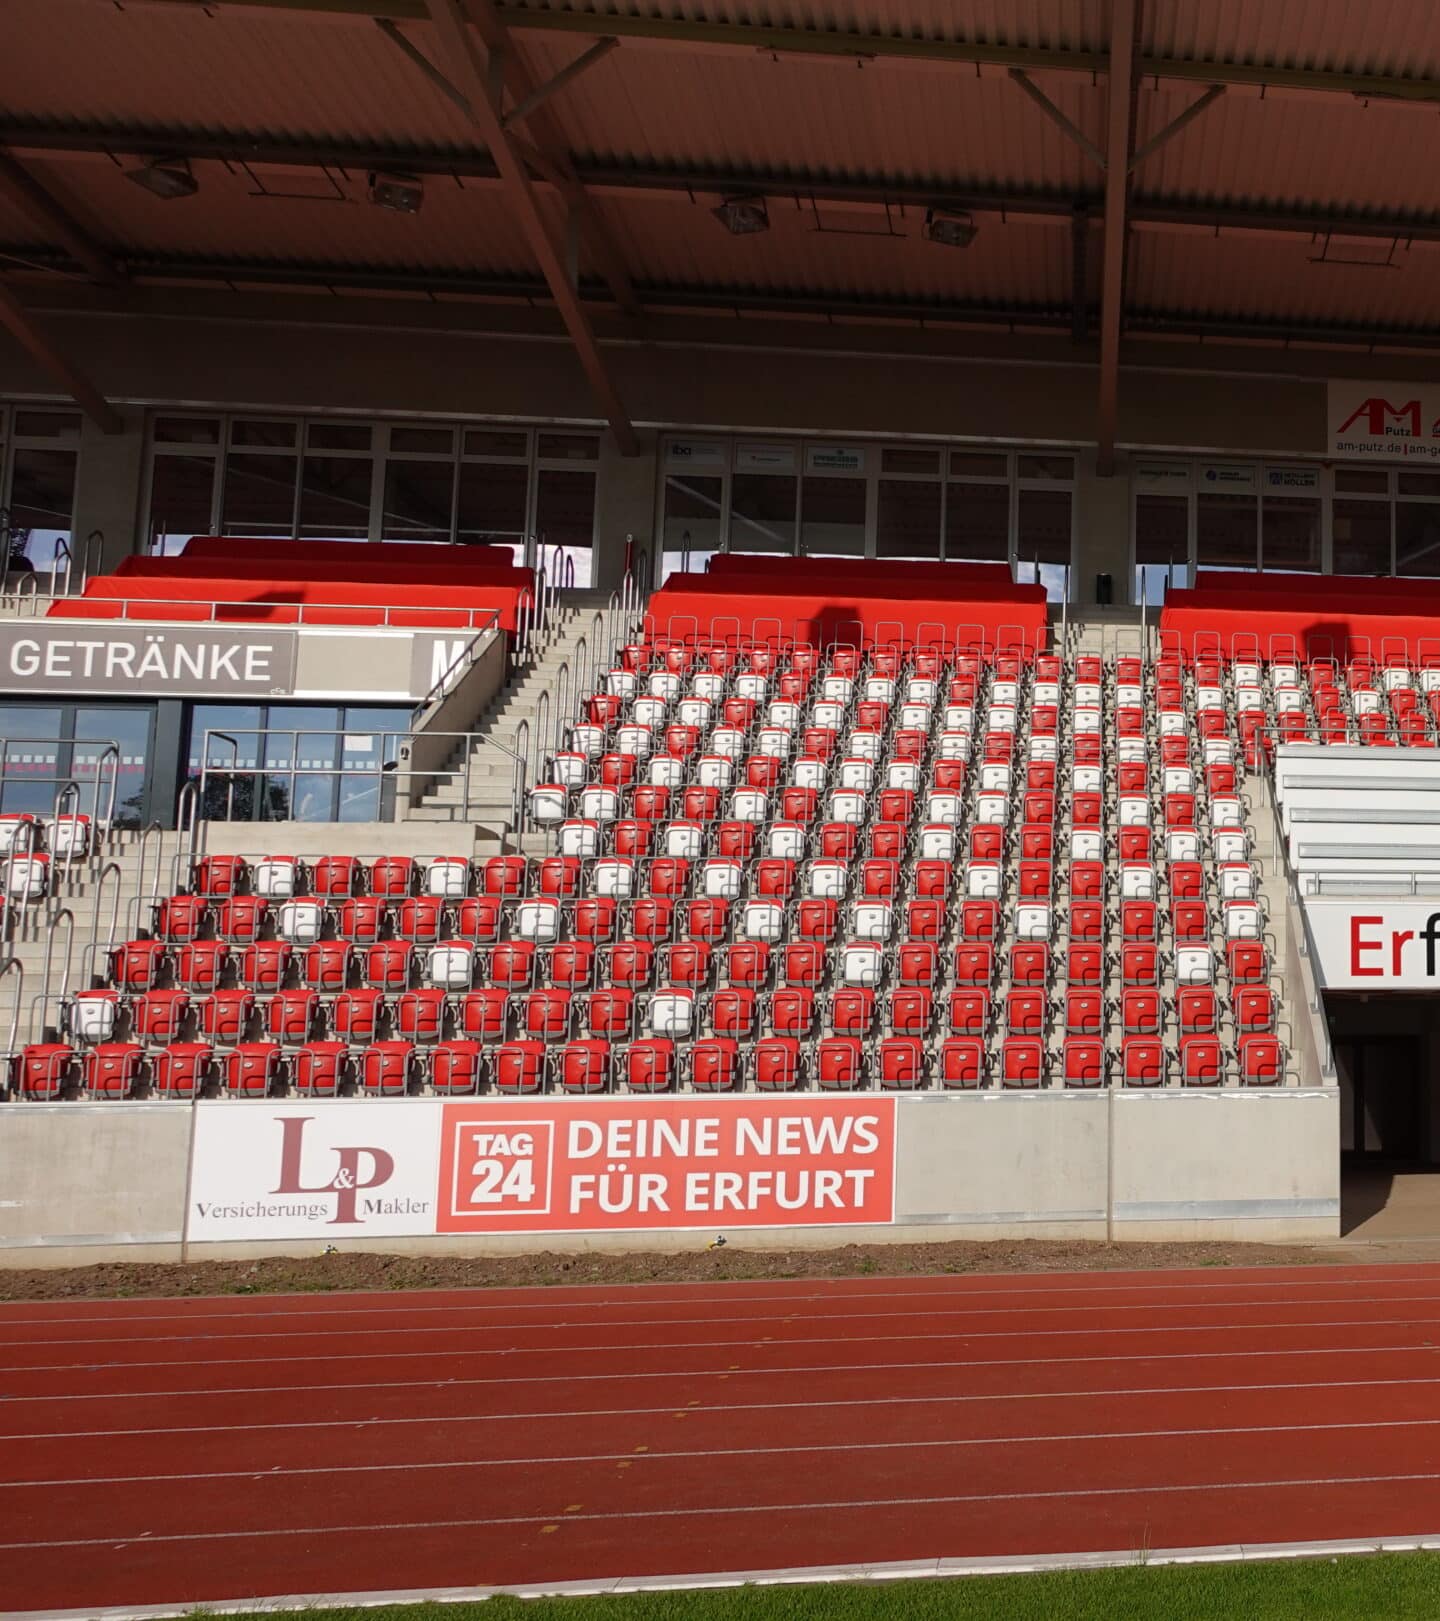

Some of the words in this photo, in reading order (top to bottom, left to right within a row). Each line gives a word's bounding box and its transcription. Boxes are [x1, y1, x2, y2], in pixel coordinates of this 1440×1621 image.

[1336, 398, 1421, 437] AM
[1385, 426, 1412, 437] Putz
[1336, 441, 1402, 453] am-putz.de
[9, 635, 273, 681] GETRÄNKE
[472, 1133, 534, 1156] TAG
[568, 1119, 720, 1159] DEINE
[735, 1116, 879, 1157] NEWS
[470, 1159, 535, 1204] 24
[569, 1163, 670, 1213] FÜR
[685, 1169, 874, 1211] ERFURT
[196, 1201, 329, 1219] Versicherungs
[363, 1198, 429, 1215] Makler
